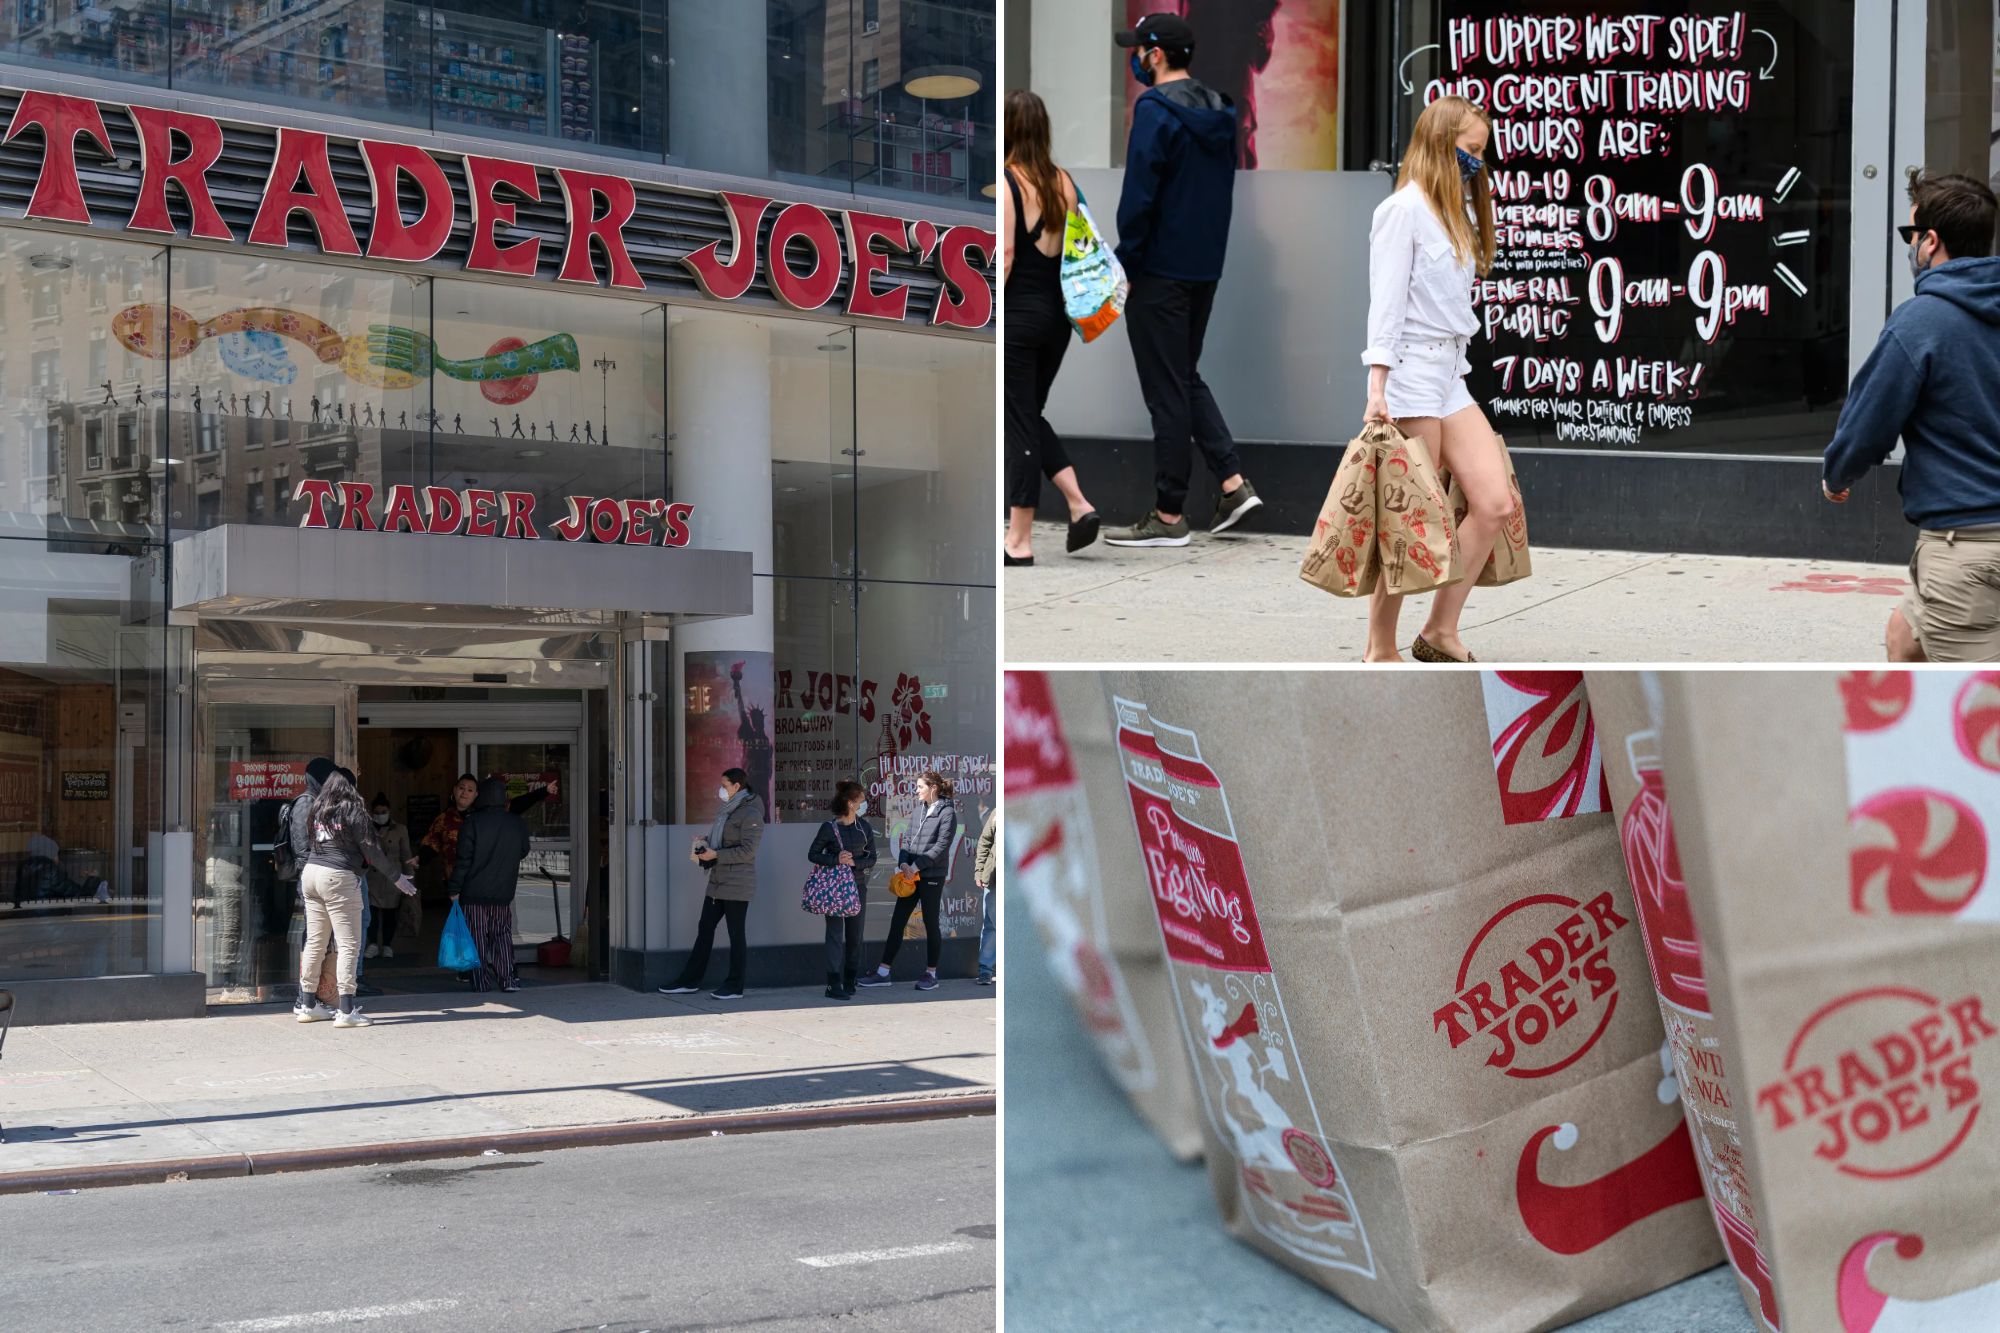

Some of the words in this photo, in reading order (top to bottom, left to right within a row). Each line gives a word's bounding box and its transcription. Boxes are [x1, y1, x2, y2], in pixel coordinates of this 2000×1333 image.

[1449, 16, 1480, 72] HI
[1485, 14, 1582, 66] UPPER
[1586, 13, 1664, 62] WEST
[1668, 11, 1745, 63] SIDE!
[1493, 72, 1617, 115] CURRENT
[1619, 69, 1750, 112] TRADING
[1492, 117, 1583, 161] HOURS
[1599, 120, 1671, 158] ARE:
[1489, 169, 1571, 201] VID-19
[3, 90, 647, 290] TRADER
[680, 190, 996, 329] JOE'S
[1491, 199, 1581, 232] LNERABLE
[1495, 225, 1584, 249] STOMERS
[1470, 276, 1580, 306] GENERAL
[1493, 355, 1519, 393] 7
[1523, 356, 1584, 396] DAYS
[1592, 358, 1613, 392] A
[1616, 356, 1705, 399] WEEK!
[1531, 399, 1550, 419] FOR
[1636, 402, 1645, 422] &
[293, 479, 540, 539] TRADER
[549, 495, 695, 548] JOE'S
[800, 671, 880, 723] JOE'S
[775, 715, 833, 734] BROADWAY
[880, 754, 891, 778] HI
[893, 754, 930, 775] UPPER
[931, 753, 961, 773] WEST
[952, 777, 993, 796] RADING
[1130, 760, 1167, 784] TRAD
[1433, 891, 1629, 1048] TRADER
[1485, 945, 1616, 1068] JOE'S
[1757, 995, 1997, 1132] TRADER
[1813, 1054, 1980, 1162] JOE'S
